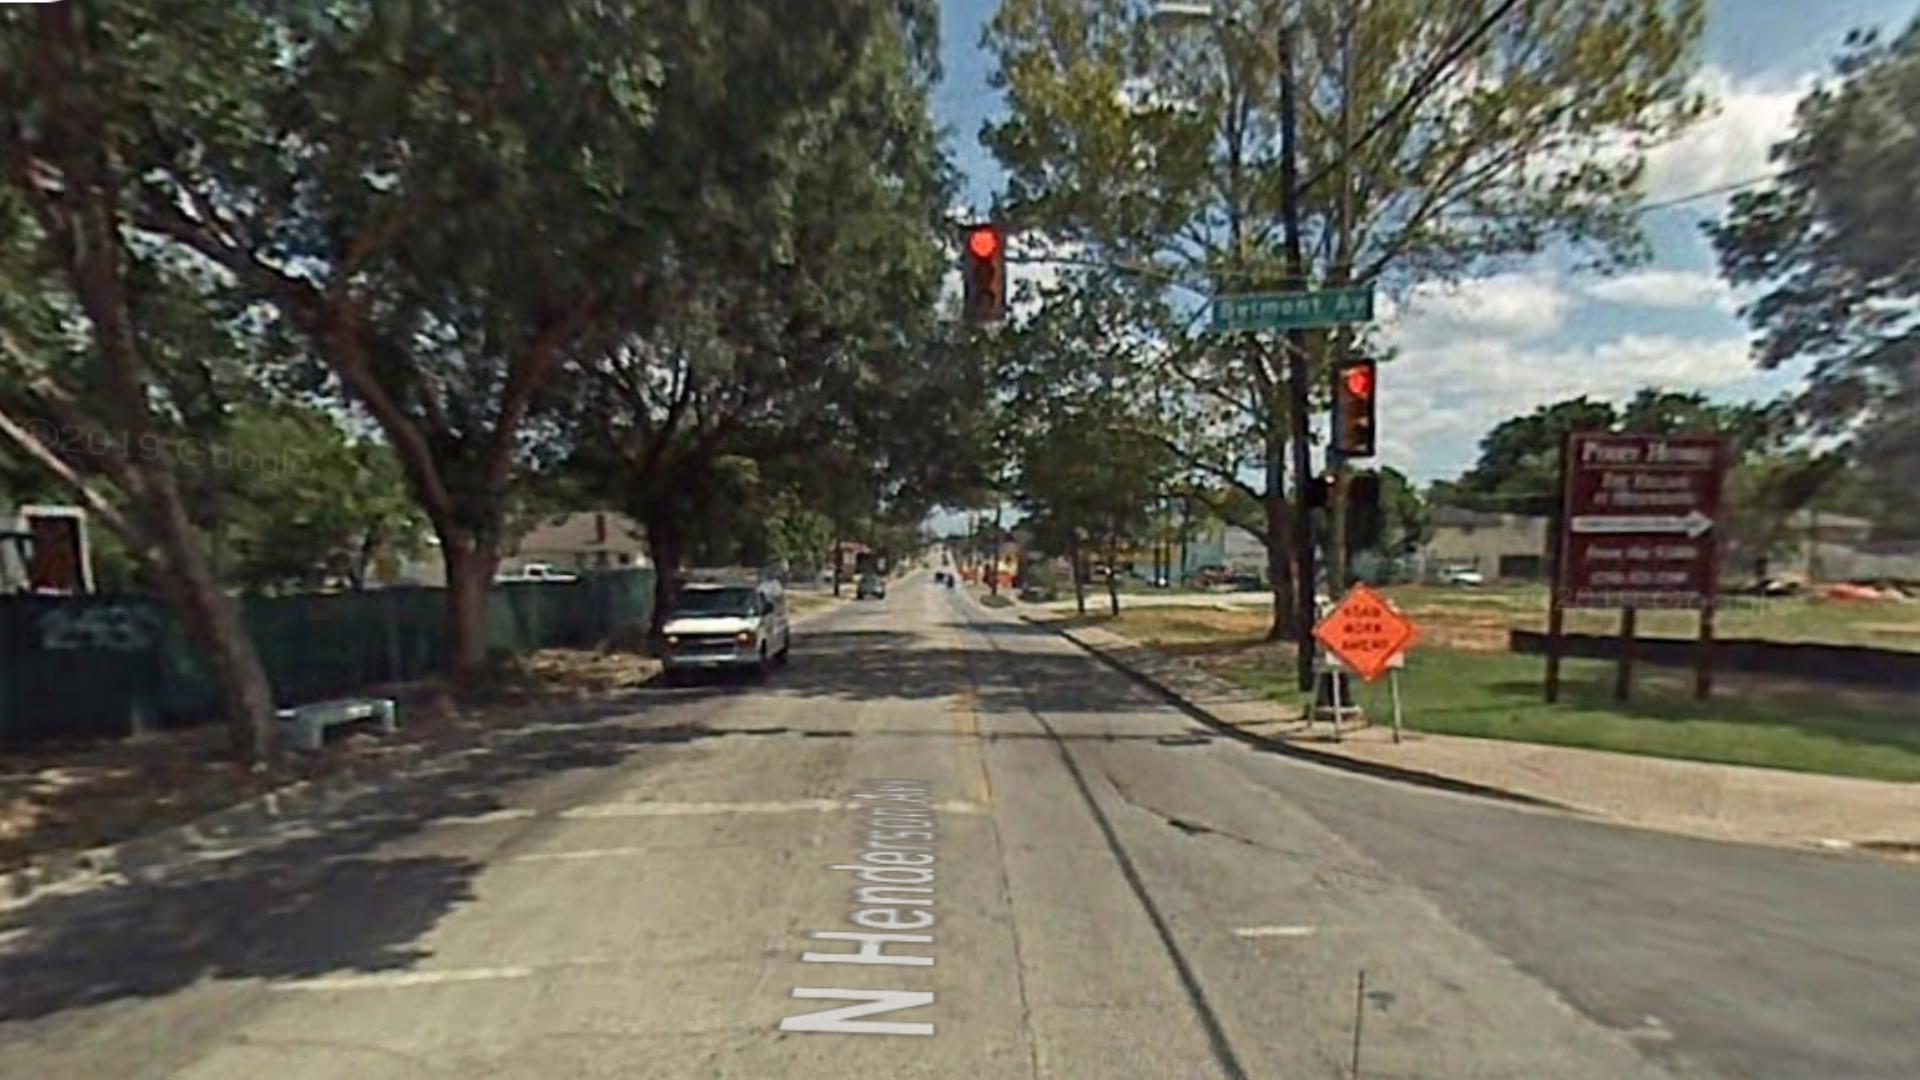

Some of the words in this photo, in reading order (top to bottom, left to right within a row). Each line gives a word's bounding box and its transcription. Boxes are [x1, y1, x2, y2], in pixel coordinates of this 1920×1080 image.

[1343, 605, 1382, 618] ROAD
[1343, 622, 1382, 634] WORK
[1341, 638, 1389, 652] AHEAD
